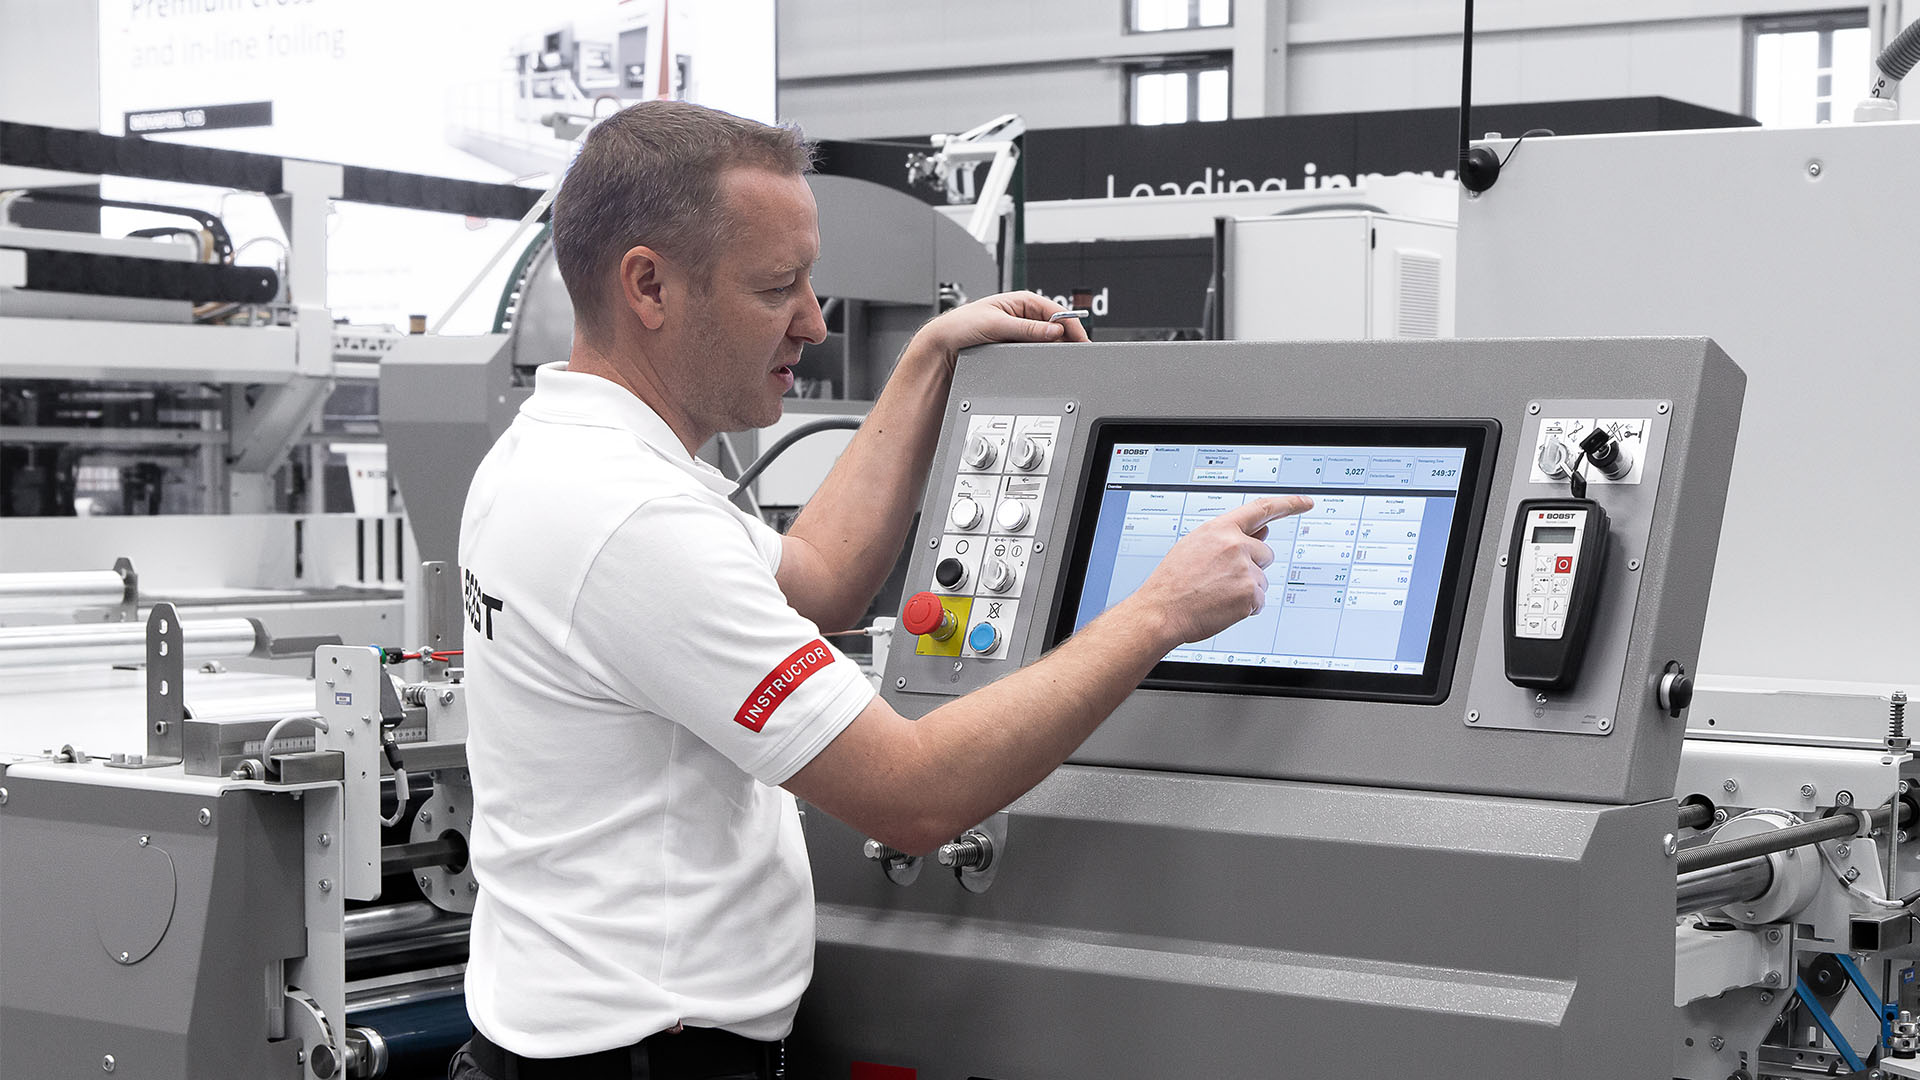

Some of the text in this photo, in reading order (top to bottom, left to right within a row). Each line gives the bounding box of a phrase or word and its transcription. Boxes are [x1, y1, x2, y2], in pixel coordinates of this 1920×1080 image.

[132, 33, 175, 68] and
[267, 21, 345, 60] foiling
[1344, 468, 1365, 476] 3,027
[1431, 469, 1457, 477] 249:37
[1397, 576, 1408, 584] 150
[744, 646, 827, 724] INSTRUCTOR
